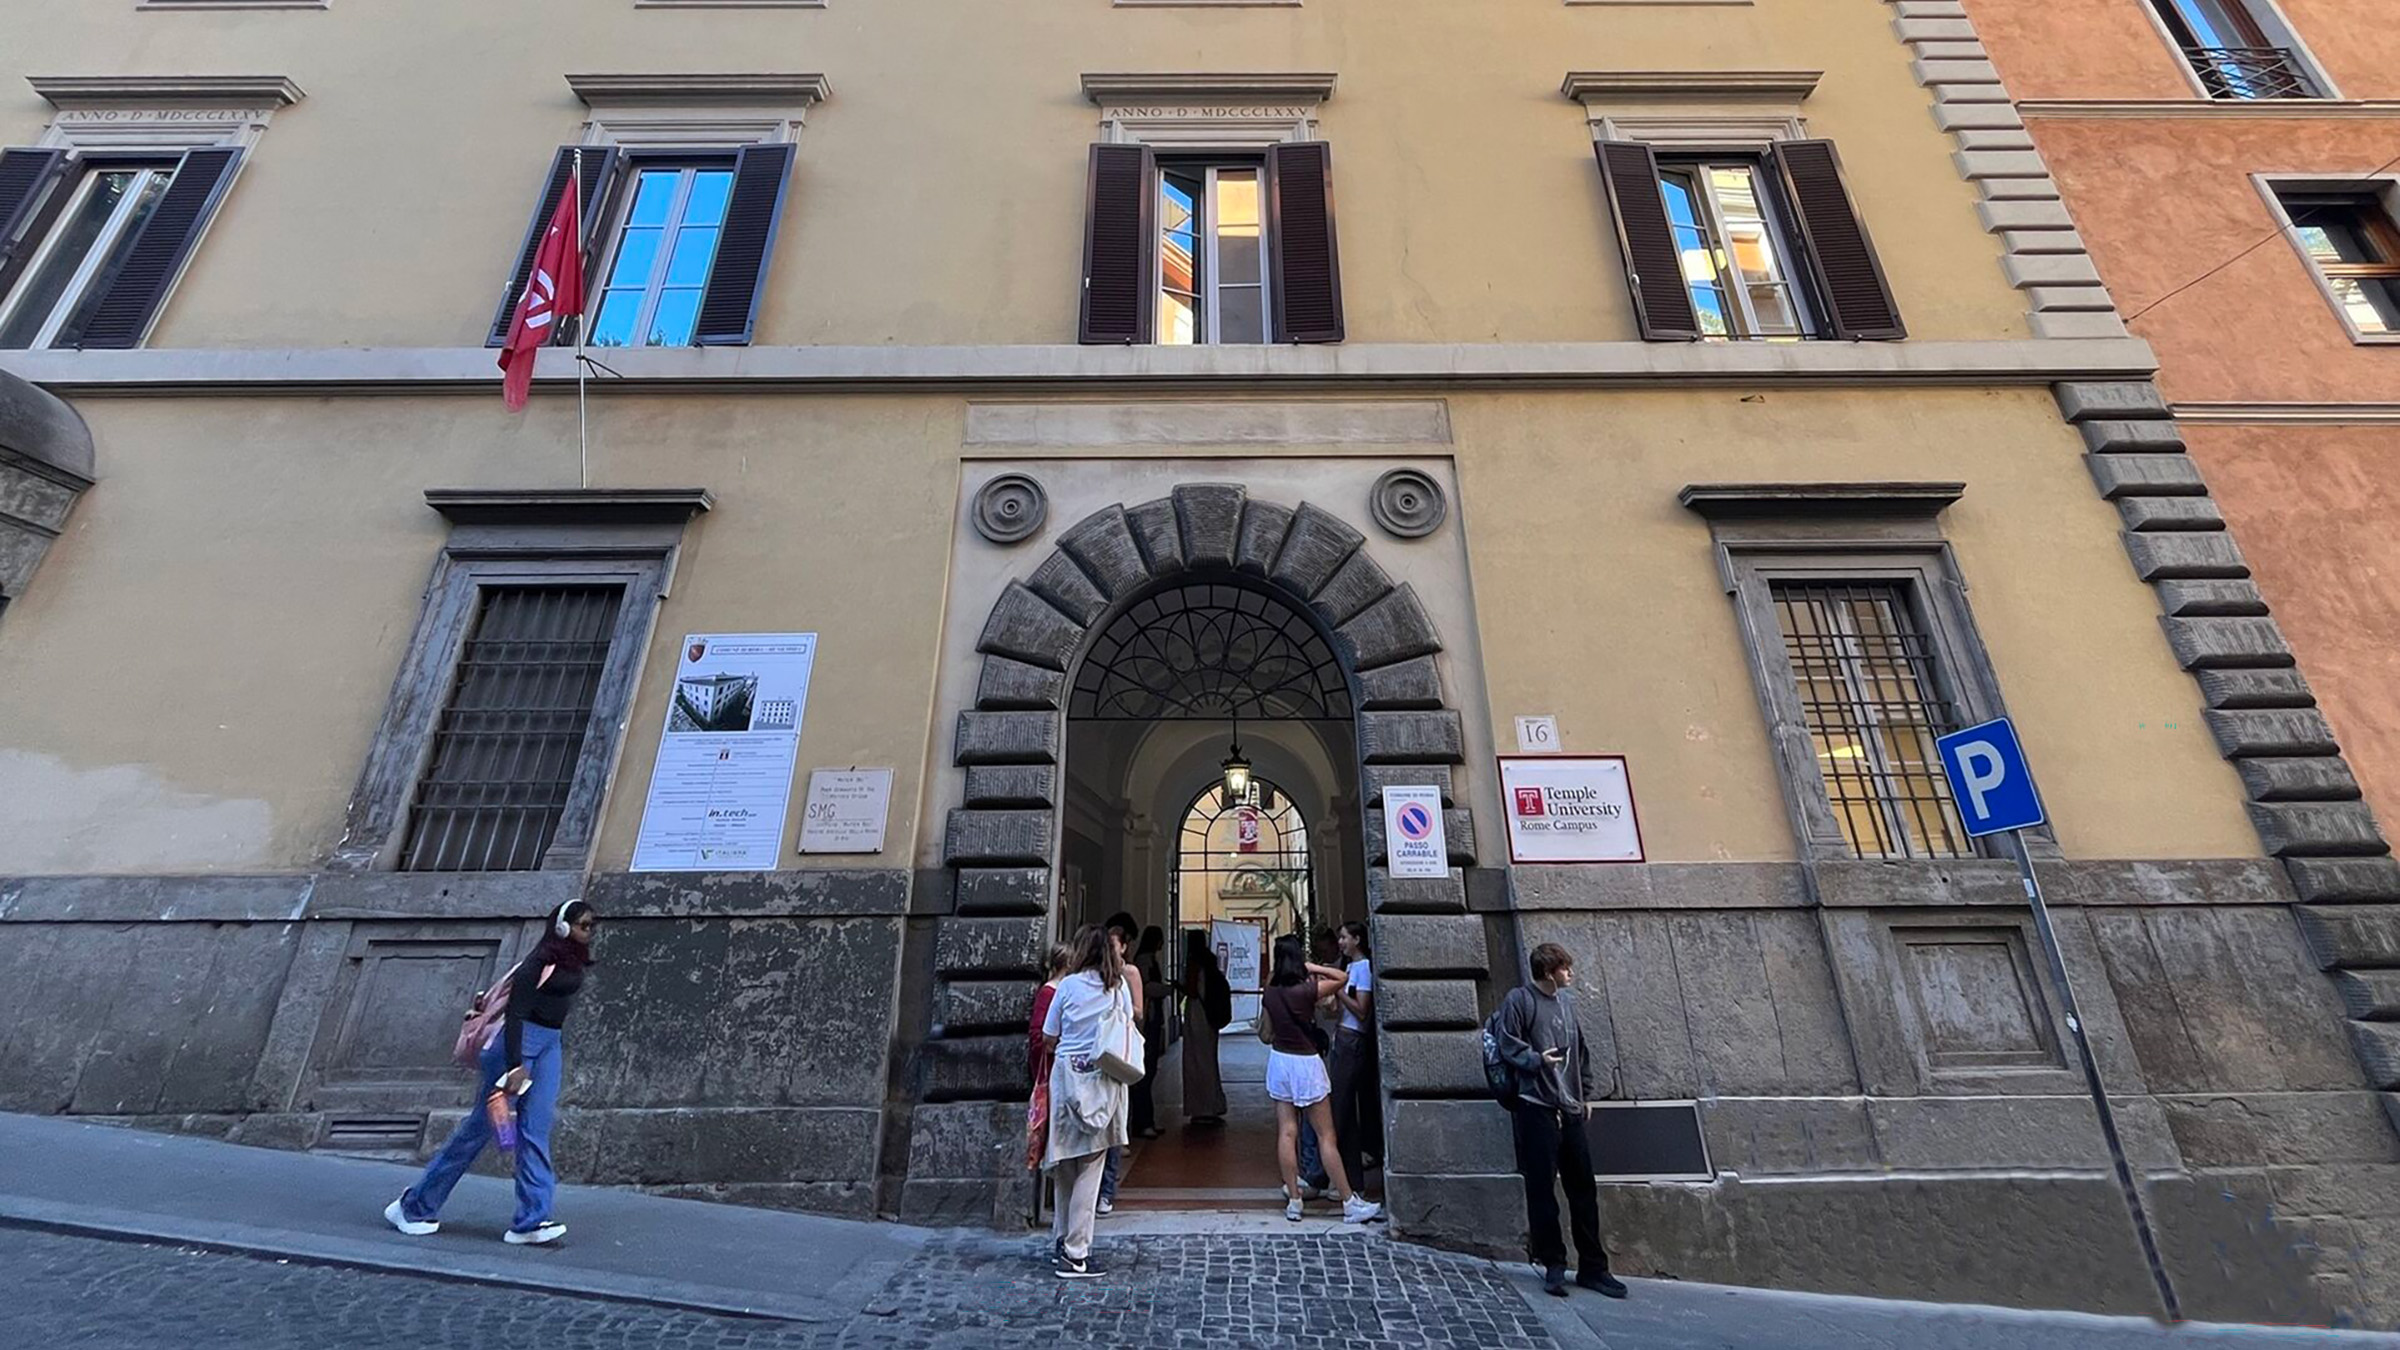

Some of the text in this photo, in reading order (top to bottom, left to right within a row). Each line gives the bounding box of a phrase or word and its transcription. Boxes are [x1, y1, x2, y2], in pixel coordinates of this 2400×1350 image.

[64, 110, 118, 121] ANNO
[130, 110, 142, 121] D
[1110, 107, 1309, 118] ANNO D MDCCCLXXV
[1525, 723, 1549, 743] 16
[1954, 740, 2005, 820] P
[1544, 786, 1597, 803] Temple
[808, 803, 836, 819] SMG
[1547, 802, 1622, 819] University
[1519, 820, 1598, 832] Rome Campus
[1396, 850, 1438, 858] CARRABILE
